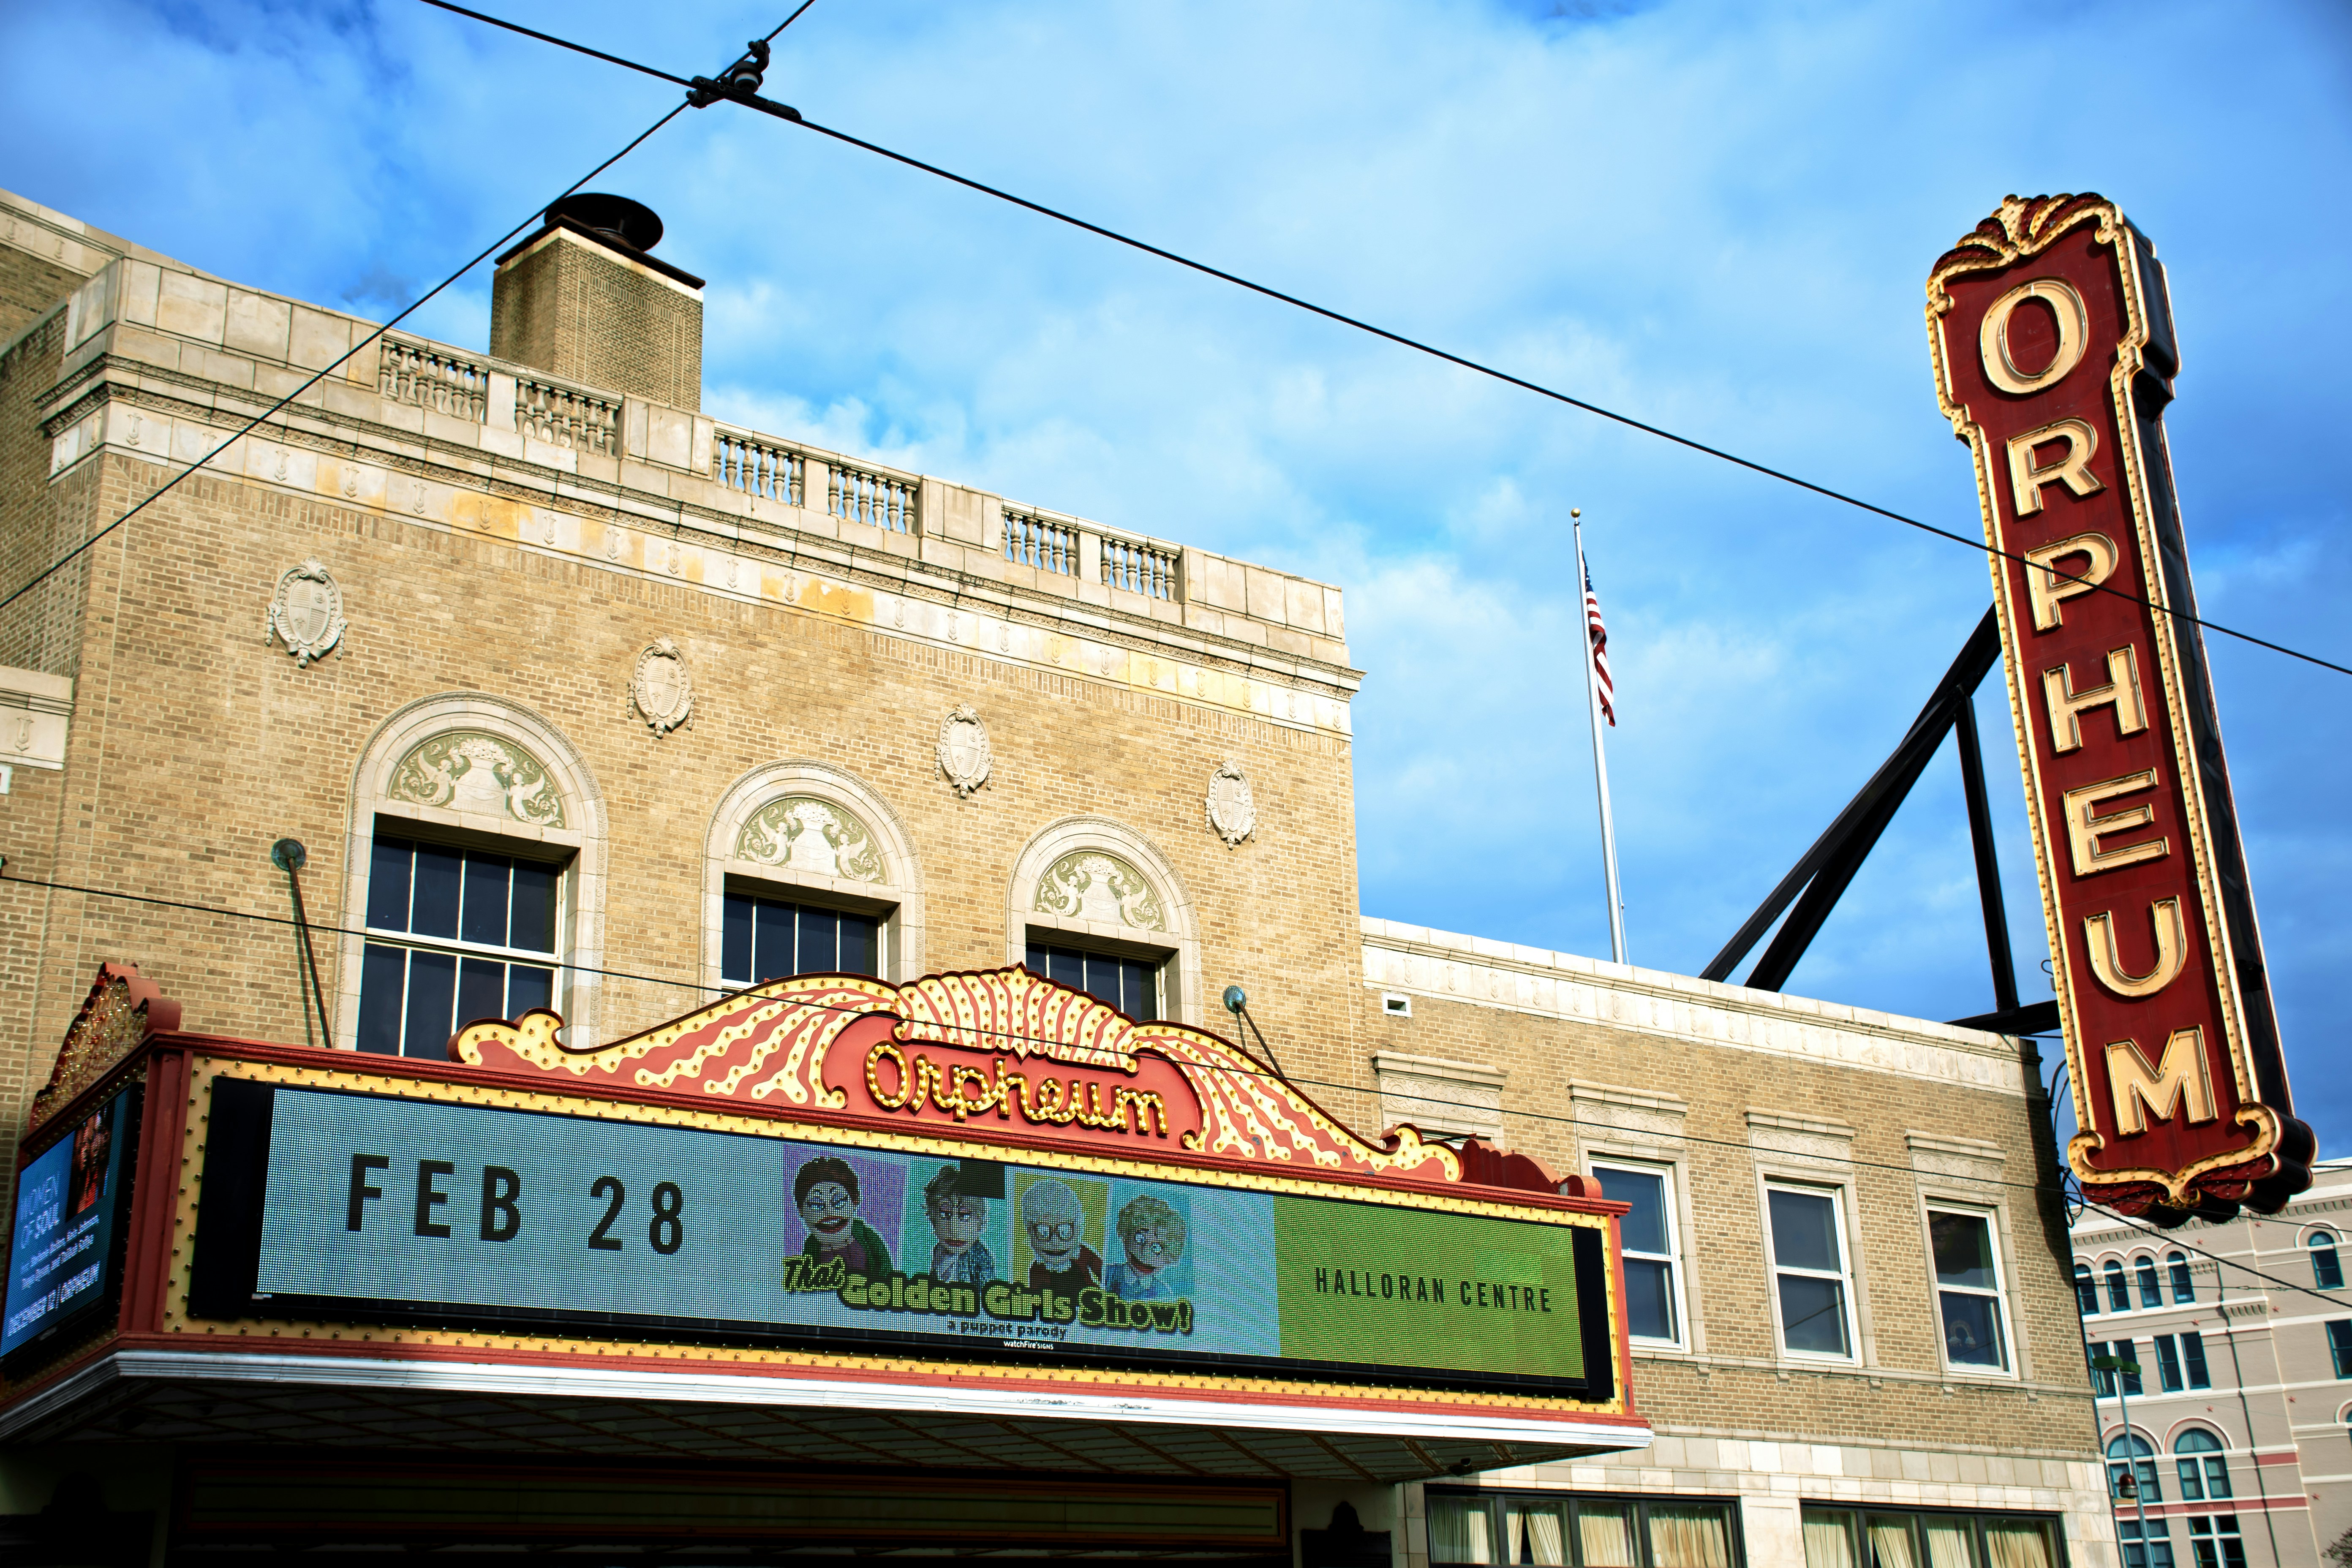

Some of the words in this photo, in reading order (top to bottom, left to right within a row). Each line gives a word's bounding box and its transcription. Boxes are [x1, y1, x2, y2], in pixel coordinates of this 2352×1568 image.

[1980, 277, 2219, 1135] ORPHEUM
[863, 1040, 1169, 1137] Orpheum
[34, 1201, 60, 1240] SOUL
[348, 1153, 521, 1242] FEB
[588, 1175, 683, 1254] 28
[60, 1260, 101, 1303] ORPHEUM
[781, 1254, 845, 1292] That
[843, 1273, 975, 1312] Golden
[984, 1284, 1074, 1319] Girls
[1078, 1286, 1192, 1333] Show!
[1315, 1267, 1445, 1303] HALLORAN
[1459, 1280, 1552, 1312] CENTRE
[947, 1320, 956, 1331] a
[961, 1320, 1013, 1337] puppet
[1017, 1323, 1067, 1341] parody
